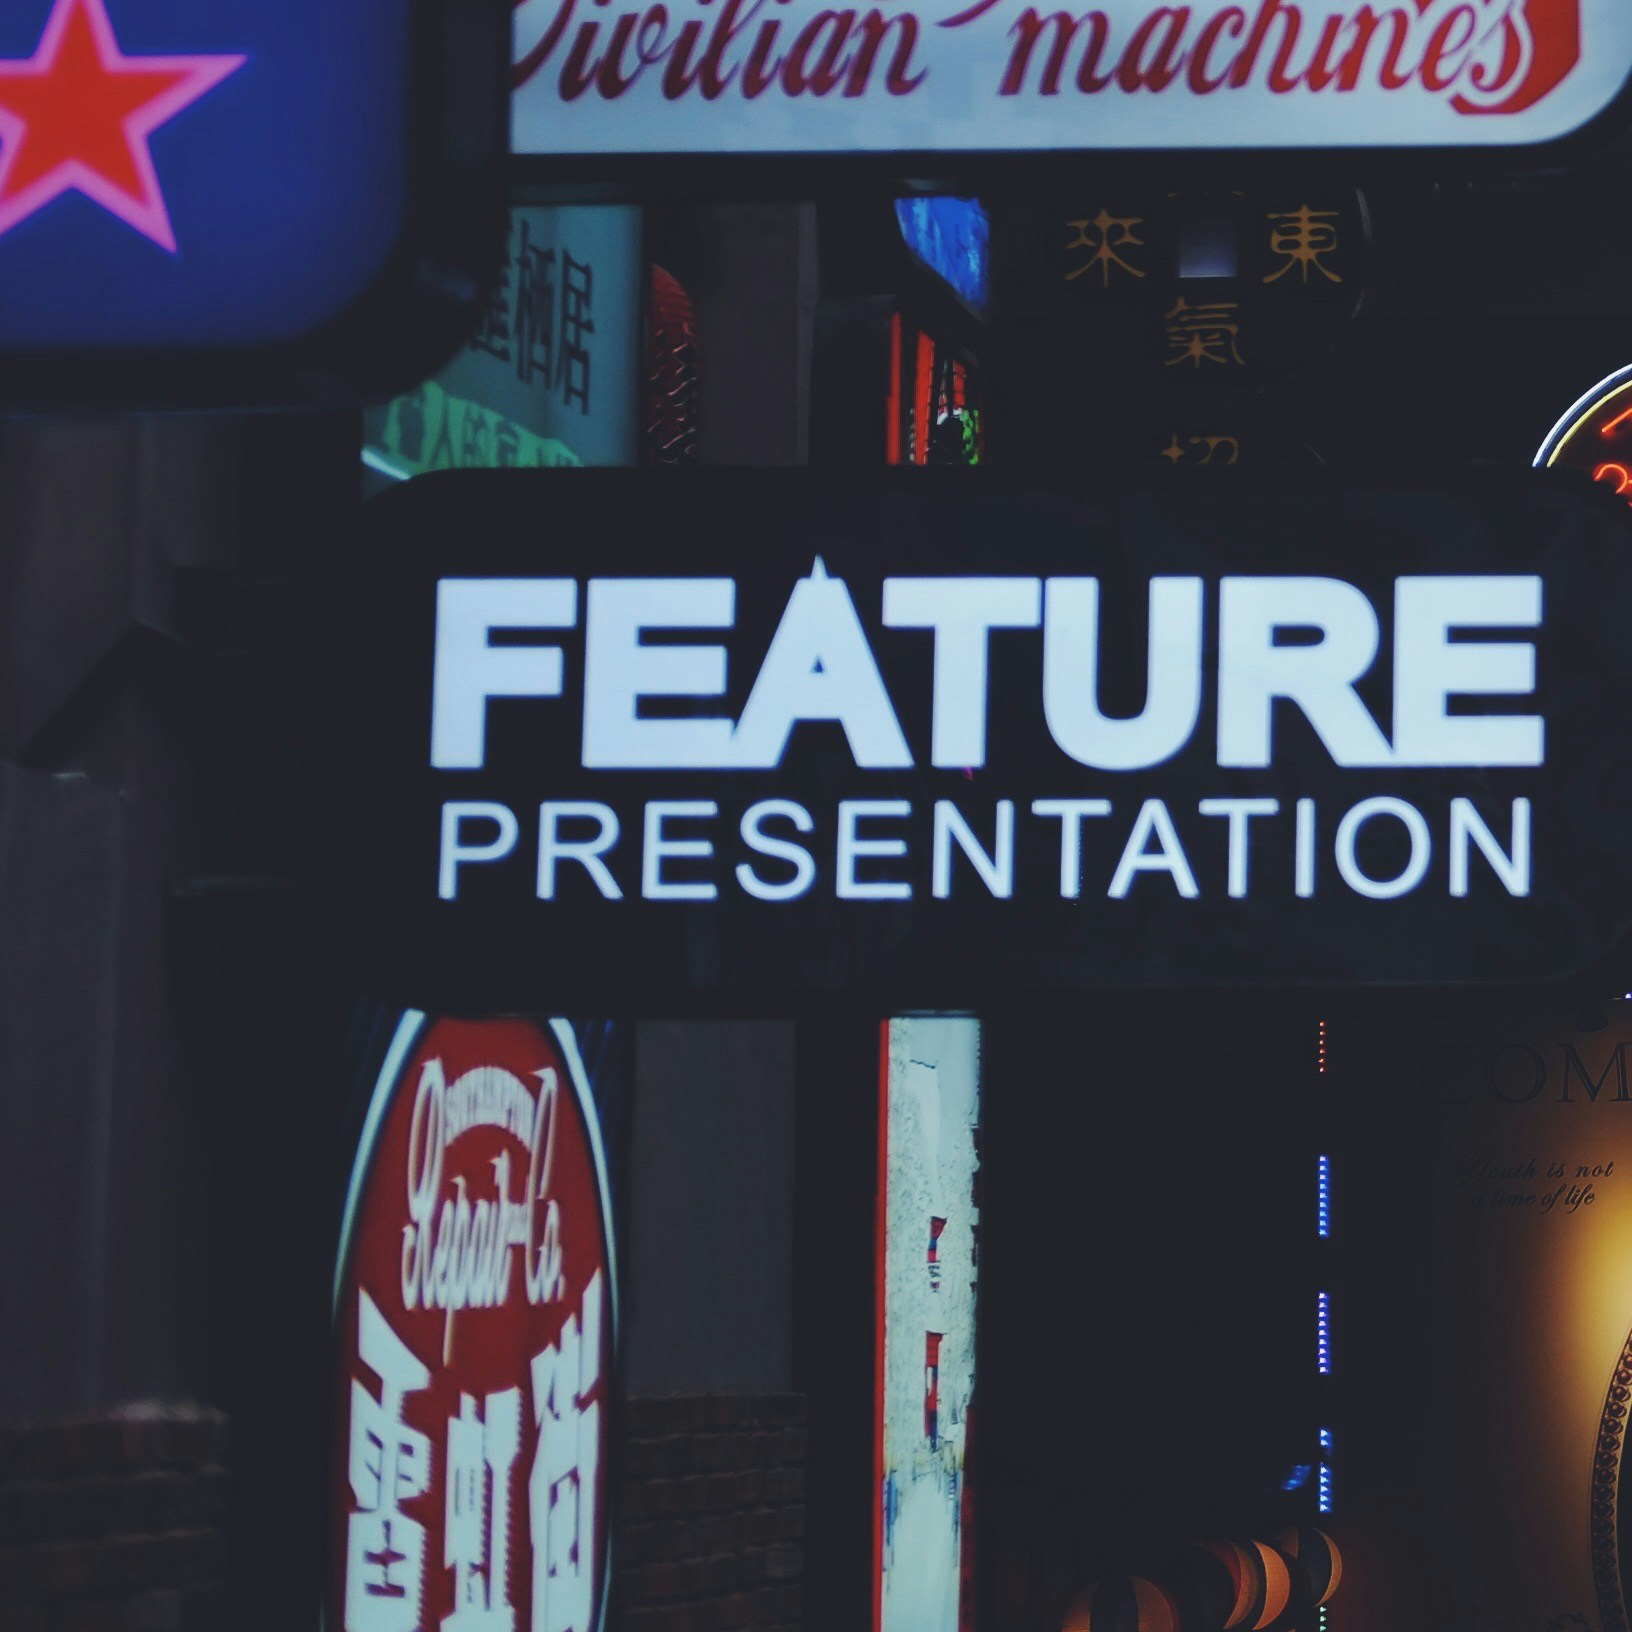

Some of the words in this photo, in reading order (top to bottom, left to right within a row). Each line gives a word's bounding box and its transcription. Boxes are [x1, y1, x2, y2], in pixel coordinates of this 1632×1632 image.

[430, 555, 1545, 770] FEATURE
[436, 795, 1533, 901] PRESENTATION
[1489, 1190, 1536, 1209] time
[1540, 1183, 1567, 1215] of
[1564, 1183, 1596, 1215] life
[1546, 1161, 1566, 1179] is
[1575, 1161, 1614, 1179] not
